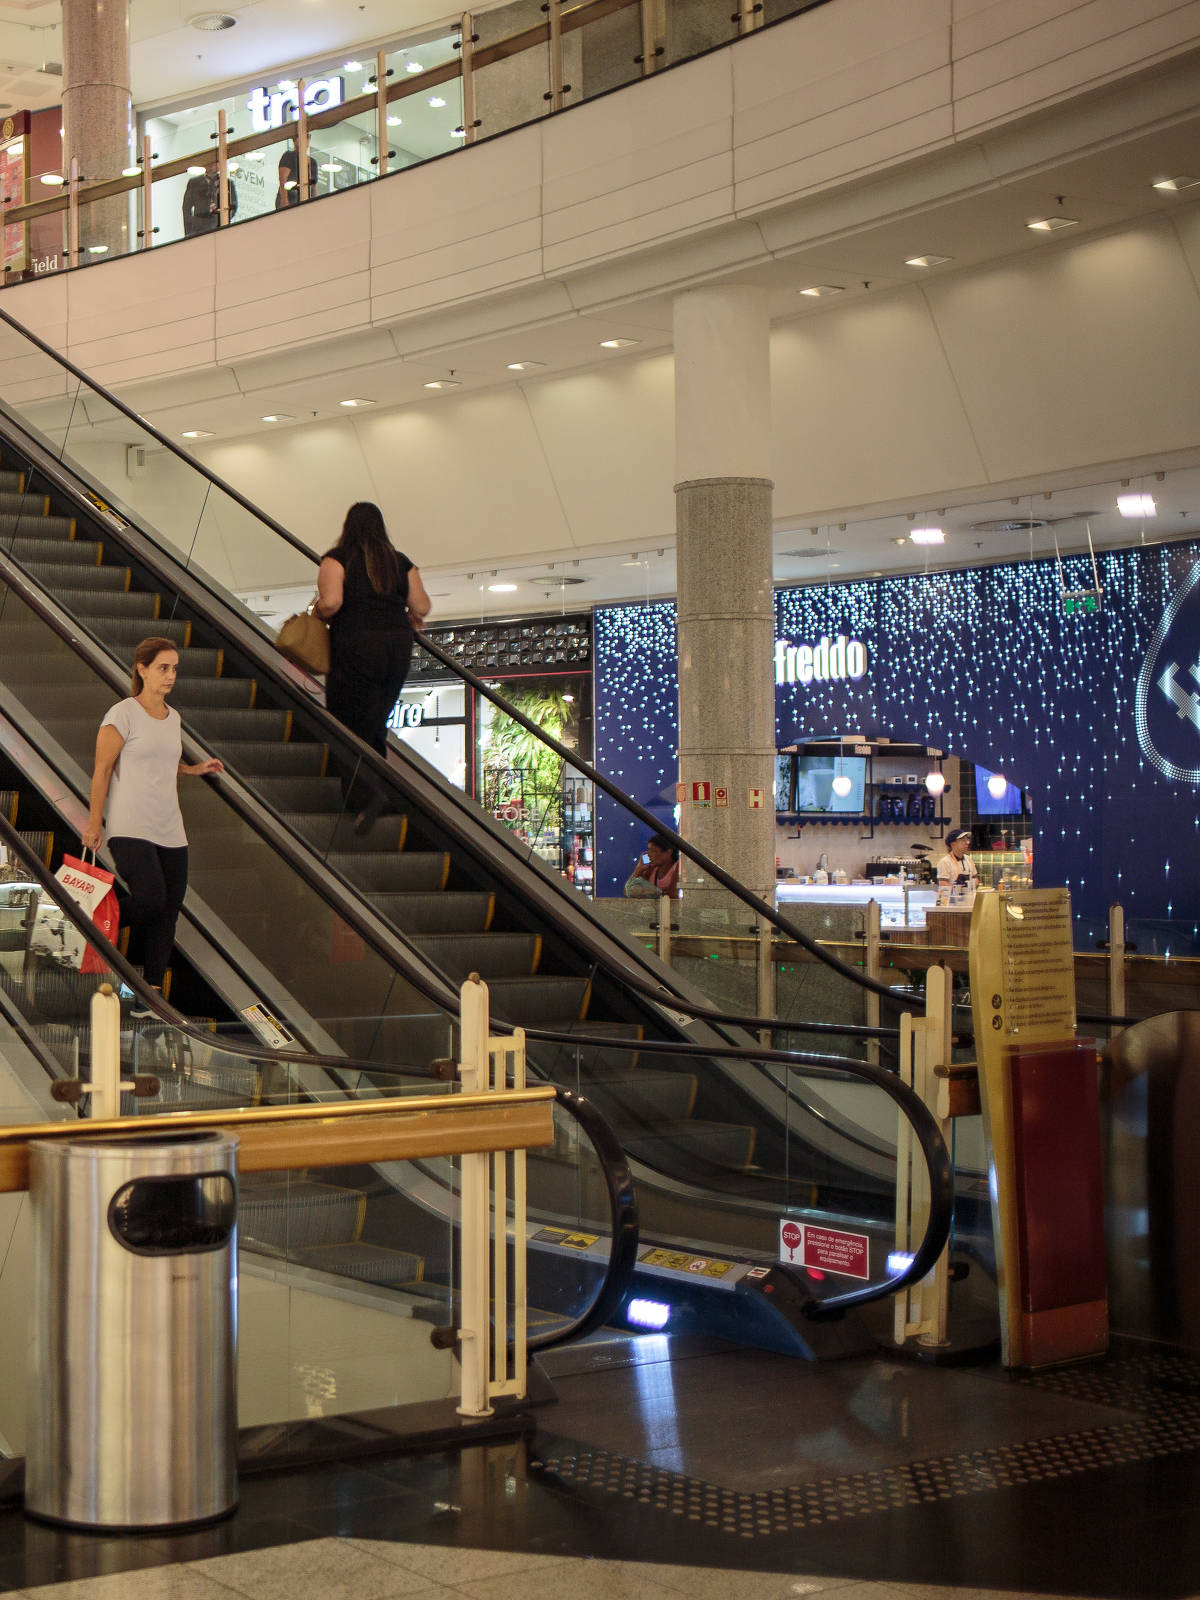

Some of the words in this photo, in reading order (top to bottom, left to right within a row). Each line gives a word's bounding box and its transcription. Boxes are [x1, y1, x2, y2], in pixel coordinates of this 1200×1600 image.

[61, 874, 96, 894] BAYARD
[783, 1231, 800, 1240] STOP
[807, 1231, 816, 1239] Em
[816, 1233, 827, 1241] caso
[817, 1248, 828, 1256] para
[849, 1247, 864, 1255] STOP
